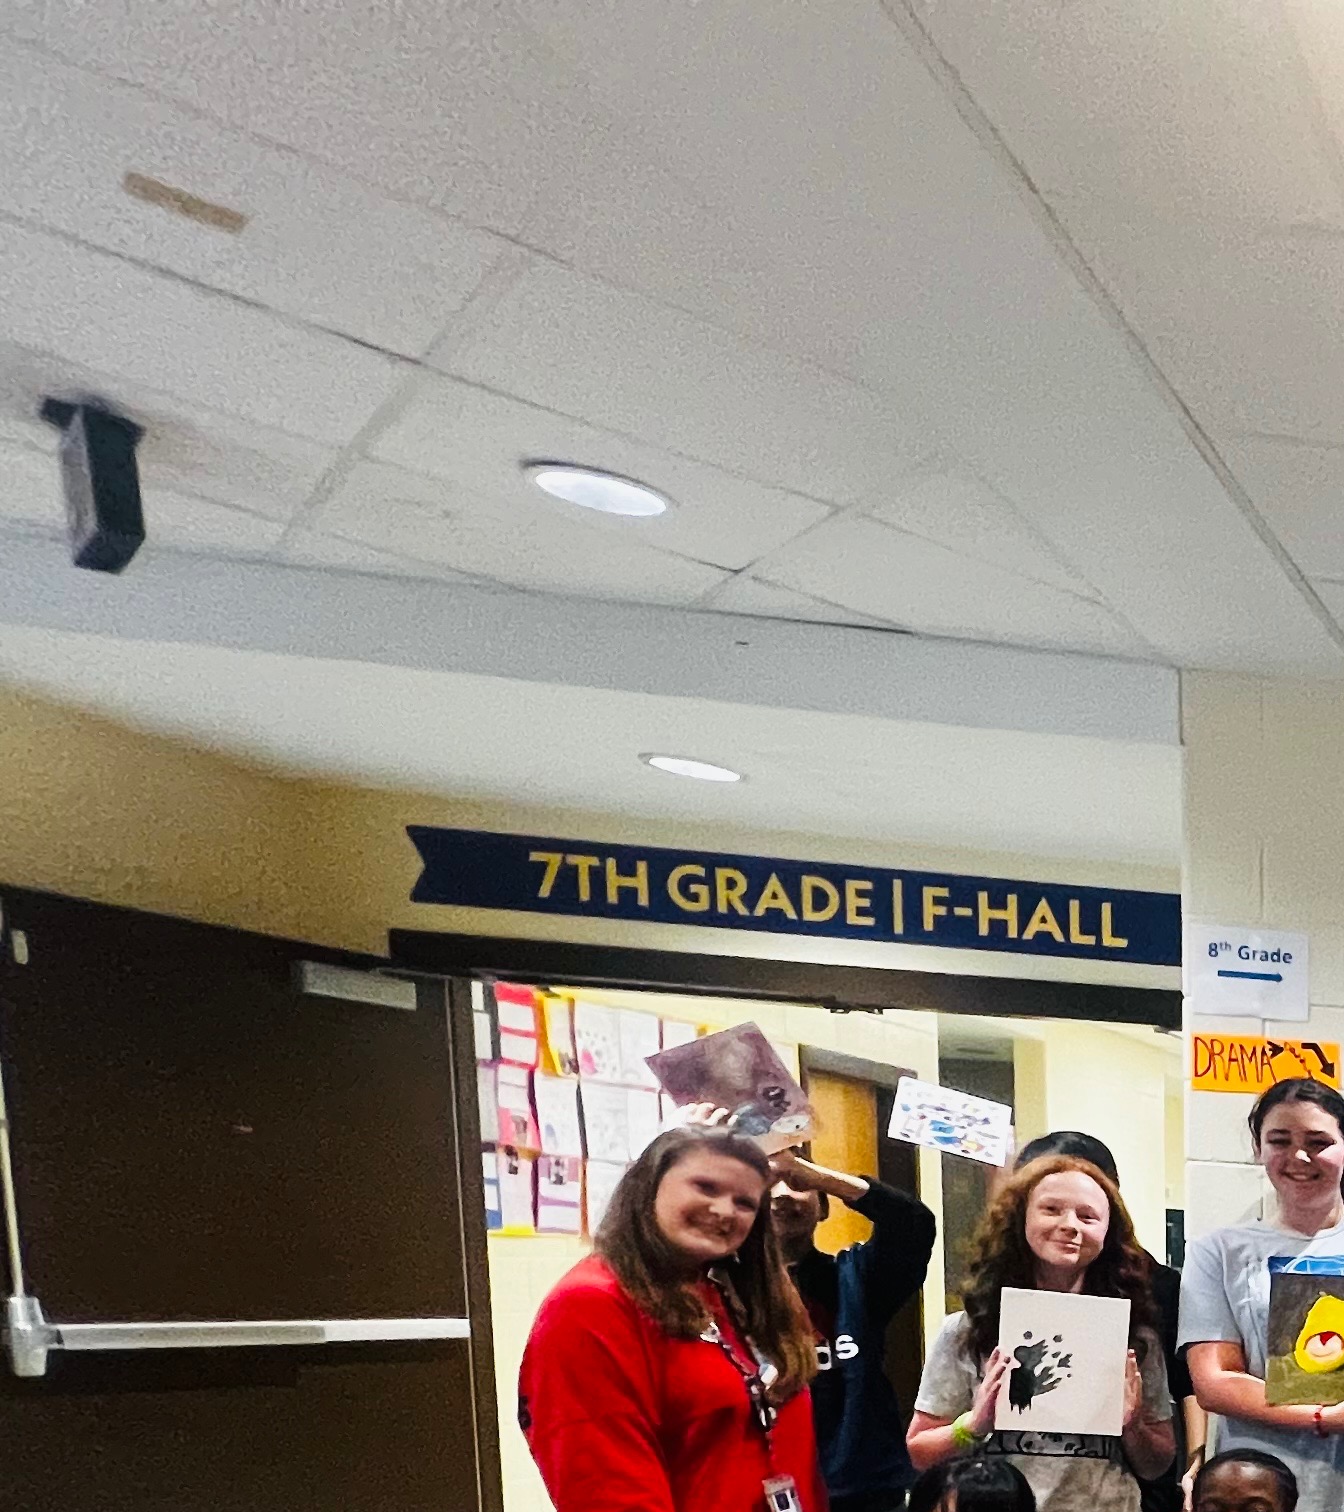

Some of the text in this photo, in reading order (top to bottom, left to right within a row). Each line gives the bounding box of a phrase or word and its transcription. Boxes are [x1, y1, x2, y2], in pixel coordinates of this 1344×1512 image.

[528, 851, 650, 907] 7TH
[666, 863, 876, 927] GRADE
[922, 885, 1129, 948] F-HALL
[1208, 941, 1293, 964] 8th Grade
[1194, 1036, 1278, 1084] DRAMA
